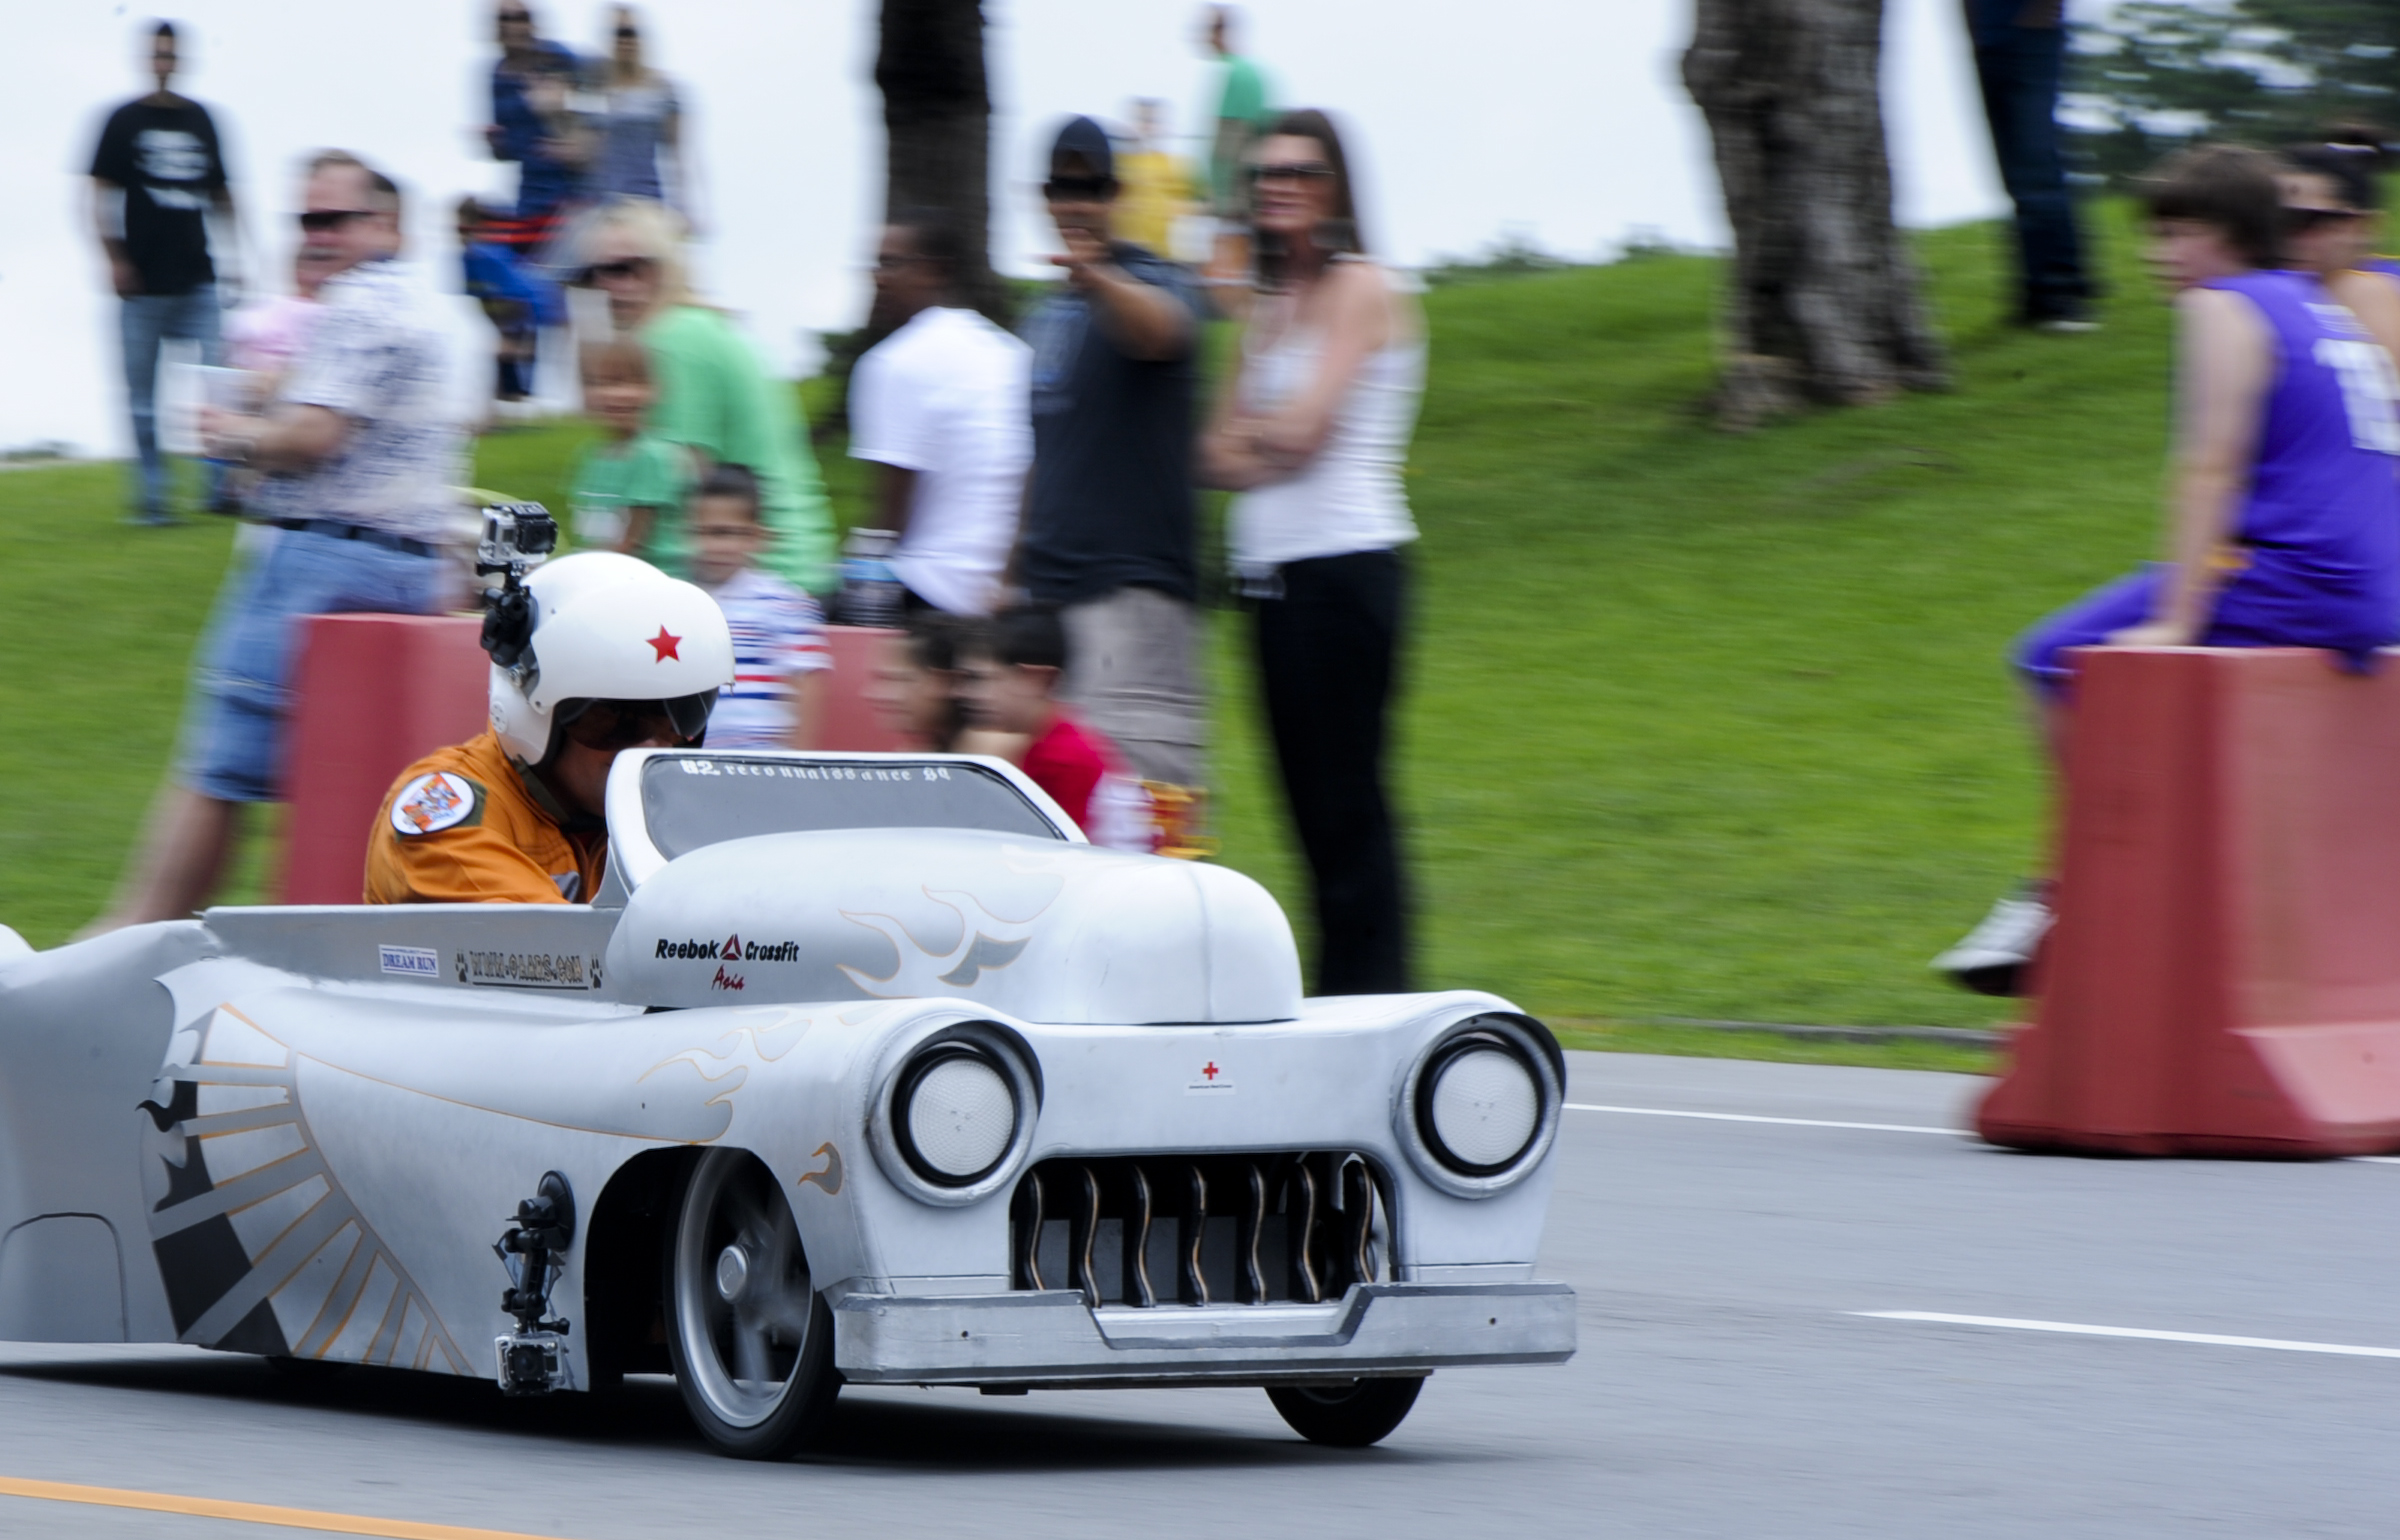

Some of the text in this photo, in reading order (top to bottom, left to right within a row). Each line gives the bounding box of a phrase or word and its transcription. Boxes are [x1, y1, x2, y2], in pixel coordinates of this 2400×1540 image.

[382, 953, 437, 971] DREAM RUN
[655, 938, 799, 962] Reebok CrossFit
[711, 963, 745, 990] Asia
